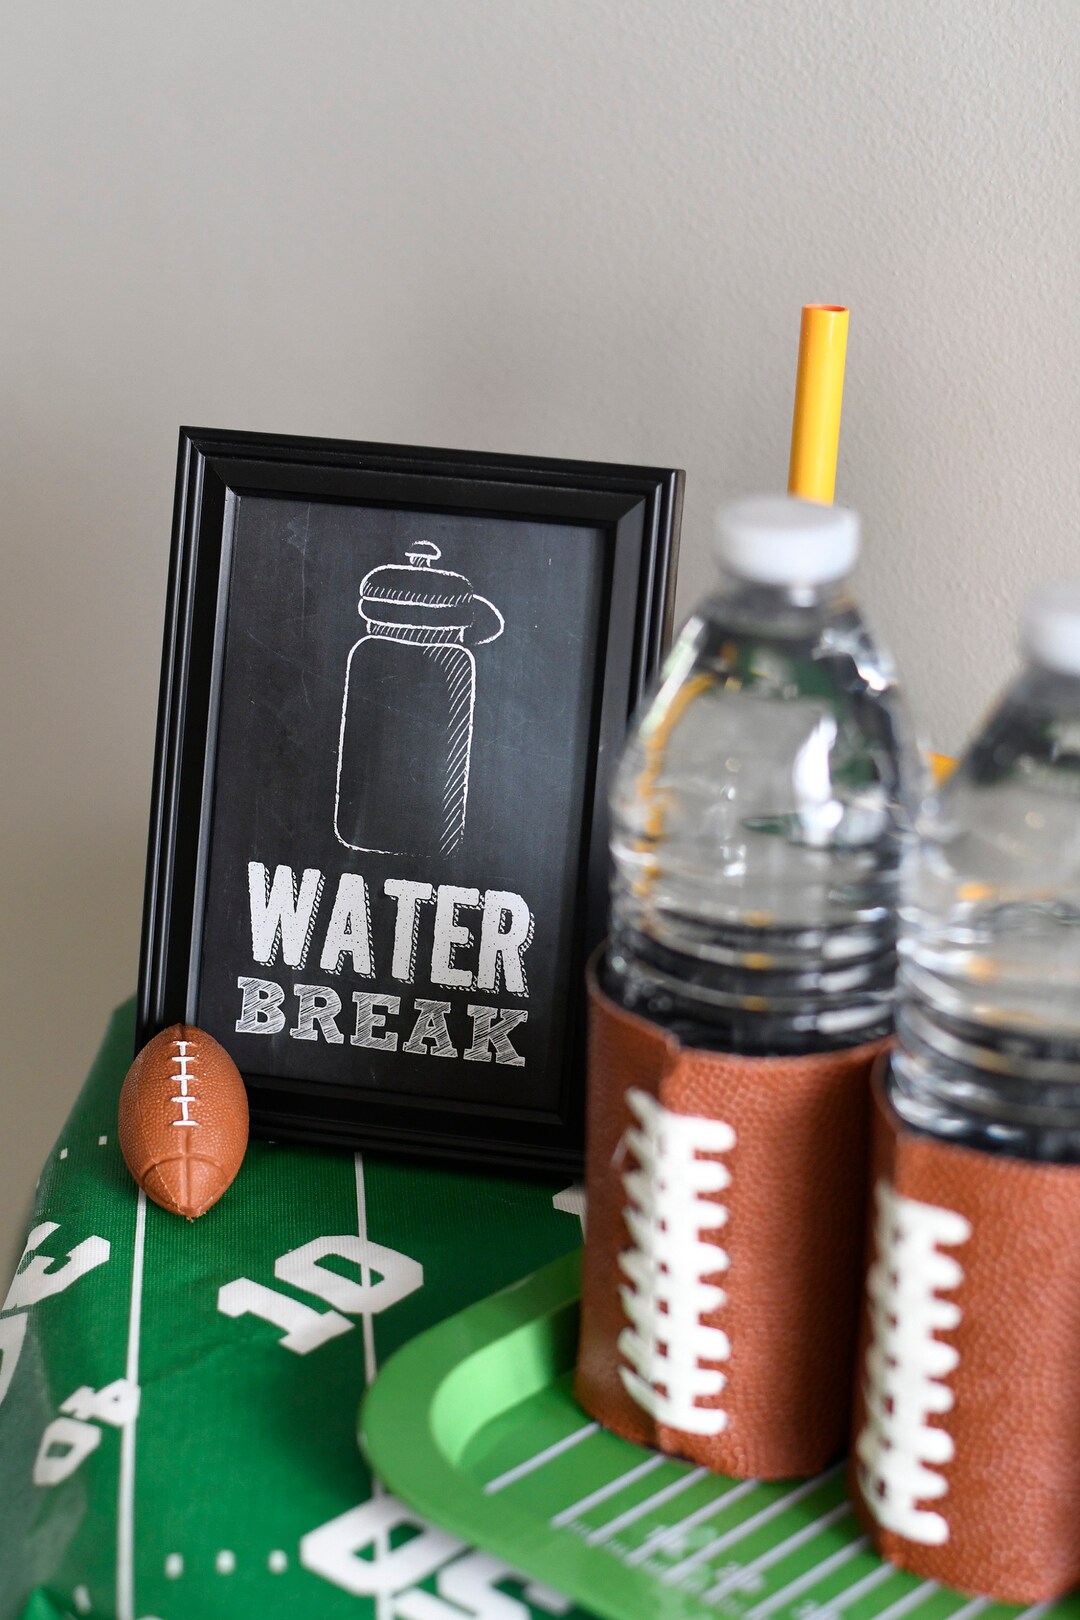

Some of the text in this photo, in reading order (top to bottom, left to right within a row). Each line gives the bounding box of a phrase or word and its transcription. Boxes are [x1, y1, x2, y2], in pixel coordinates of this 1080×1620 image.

[248, 861, 535, 998] WATER
[235, 976, 529, 1067] BREAK
[217, 1235, 424, 1355] 10
